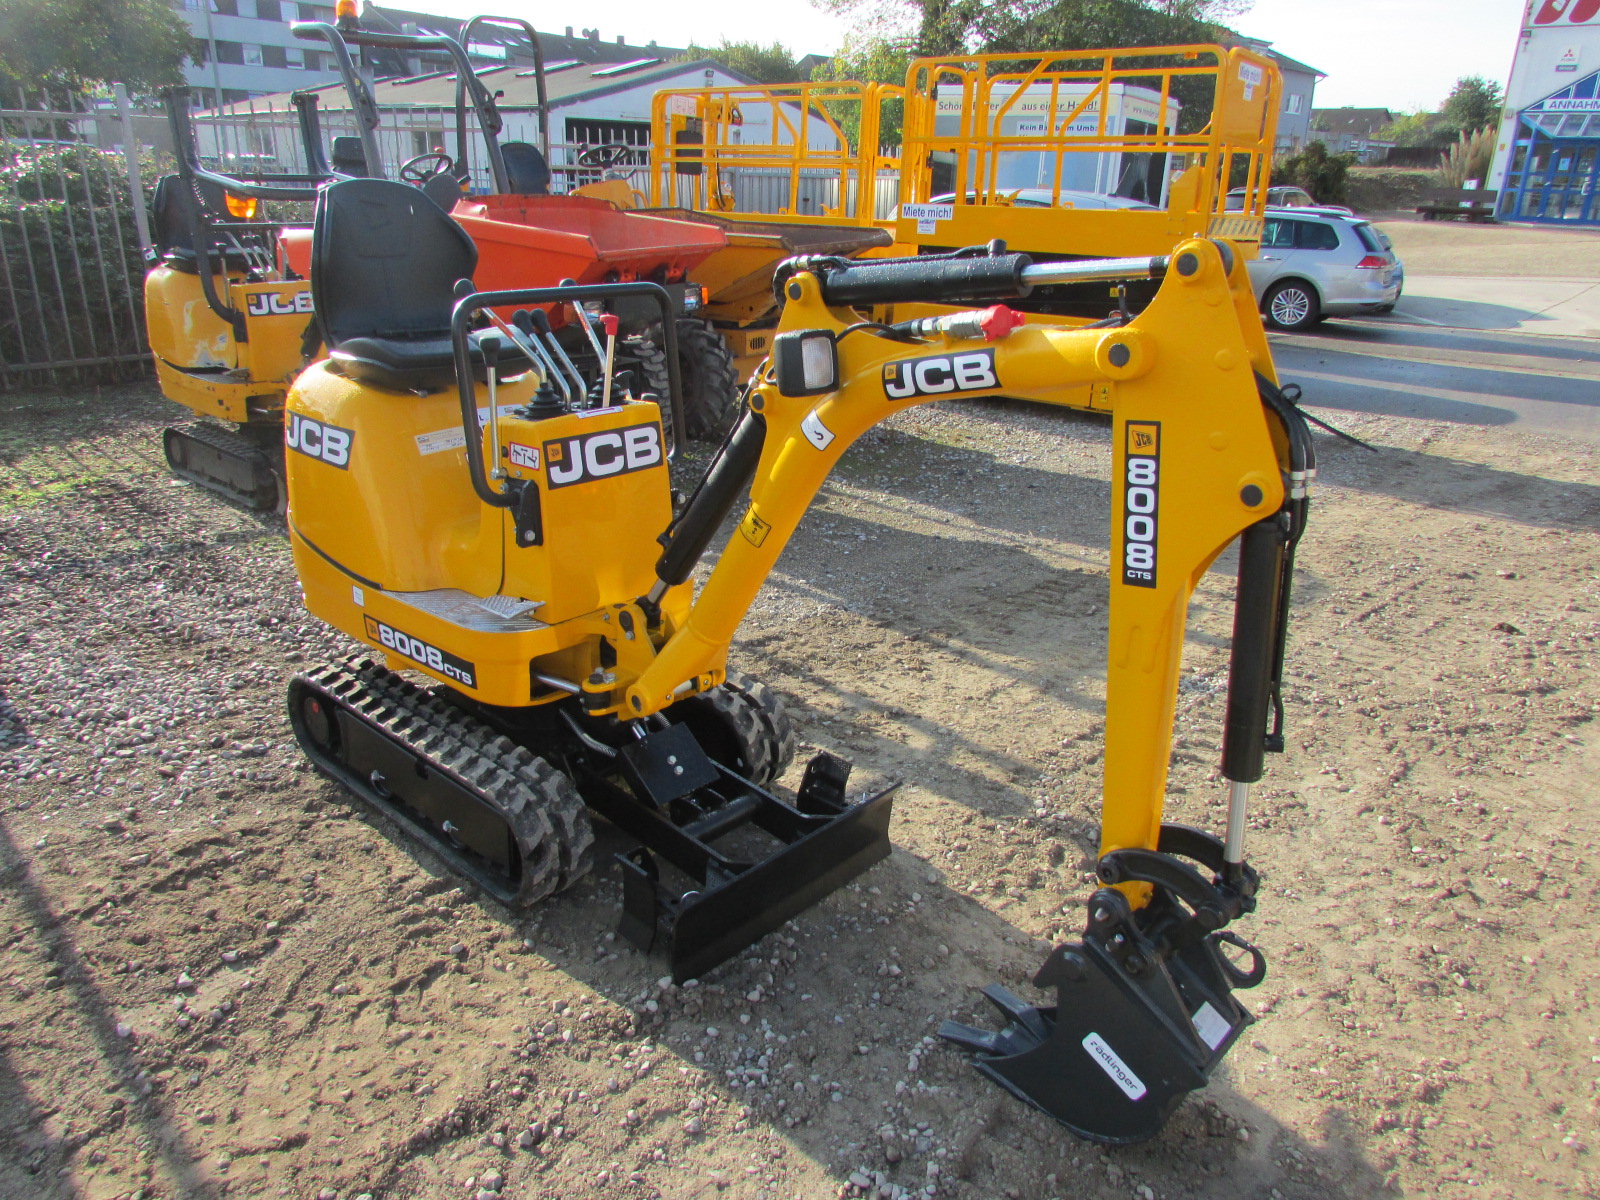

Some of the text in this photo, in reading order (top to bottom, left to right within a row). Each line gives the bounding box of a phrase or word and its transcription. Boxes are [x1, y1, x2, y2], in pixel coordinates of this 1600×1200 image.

[1021, 103, 1037, 111] aus
[1039, 101, 1065, 111] eier
[1067, 101, 1098, 111] Hd!
[903, 206, 952, 218] Miete mich!
[249, 291, 316, 315] JCB
[886, 353, 996, 398] JCB
[286, 415, 350, 466] JCB
[549, 426, 661, 484] JCB
[1135, 432, 1154, 447] JCB
[1126, 458, 1156, 570] 8008
[1126, 570, 1152, 580] CTS
[1090, 1040, 1138, 1090] rädlinger
